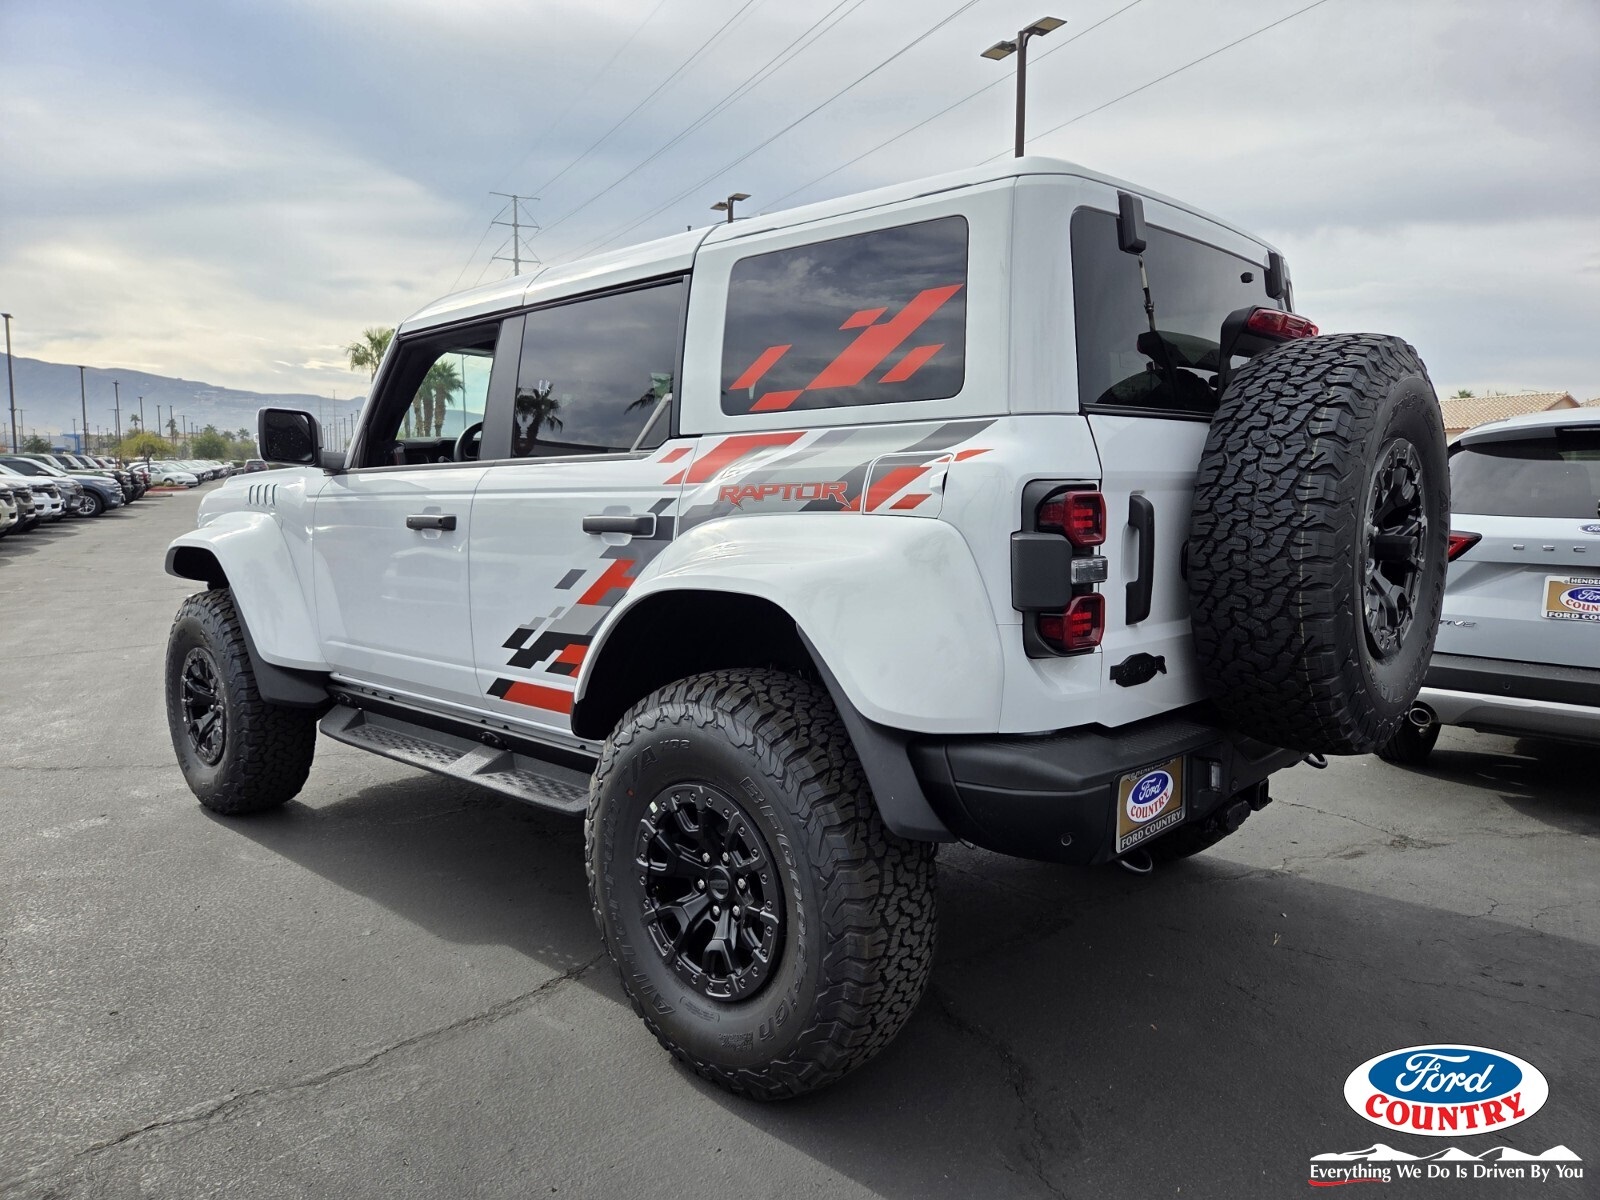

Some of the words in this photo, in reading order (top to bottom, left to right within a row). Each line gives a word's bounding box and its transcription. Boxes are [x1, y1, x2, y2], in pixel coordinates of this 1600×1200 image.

[718, 481, 851, 510] RAPTOR
[1548, 611, 1580, 619] FORD
[1130, 787, 1169, 818] COUNTRY
[1138, 777, 1162, 801] Ford
[1121, 830, 1144, 849] FORD
[1144, 809, 1182, 835] COUNTRY
